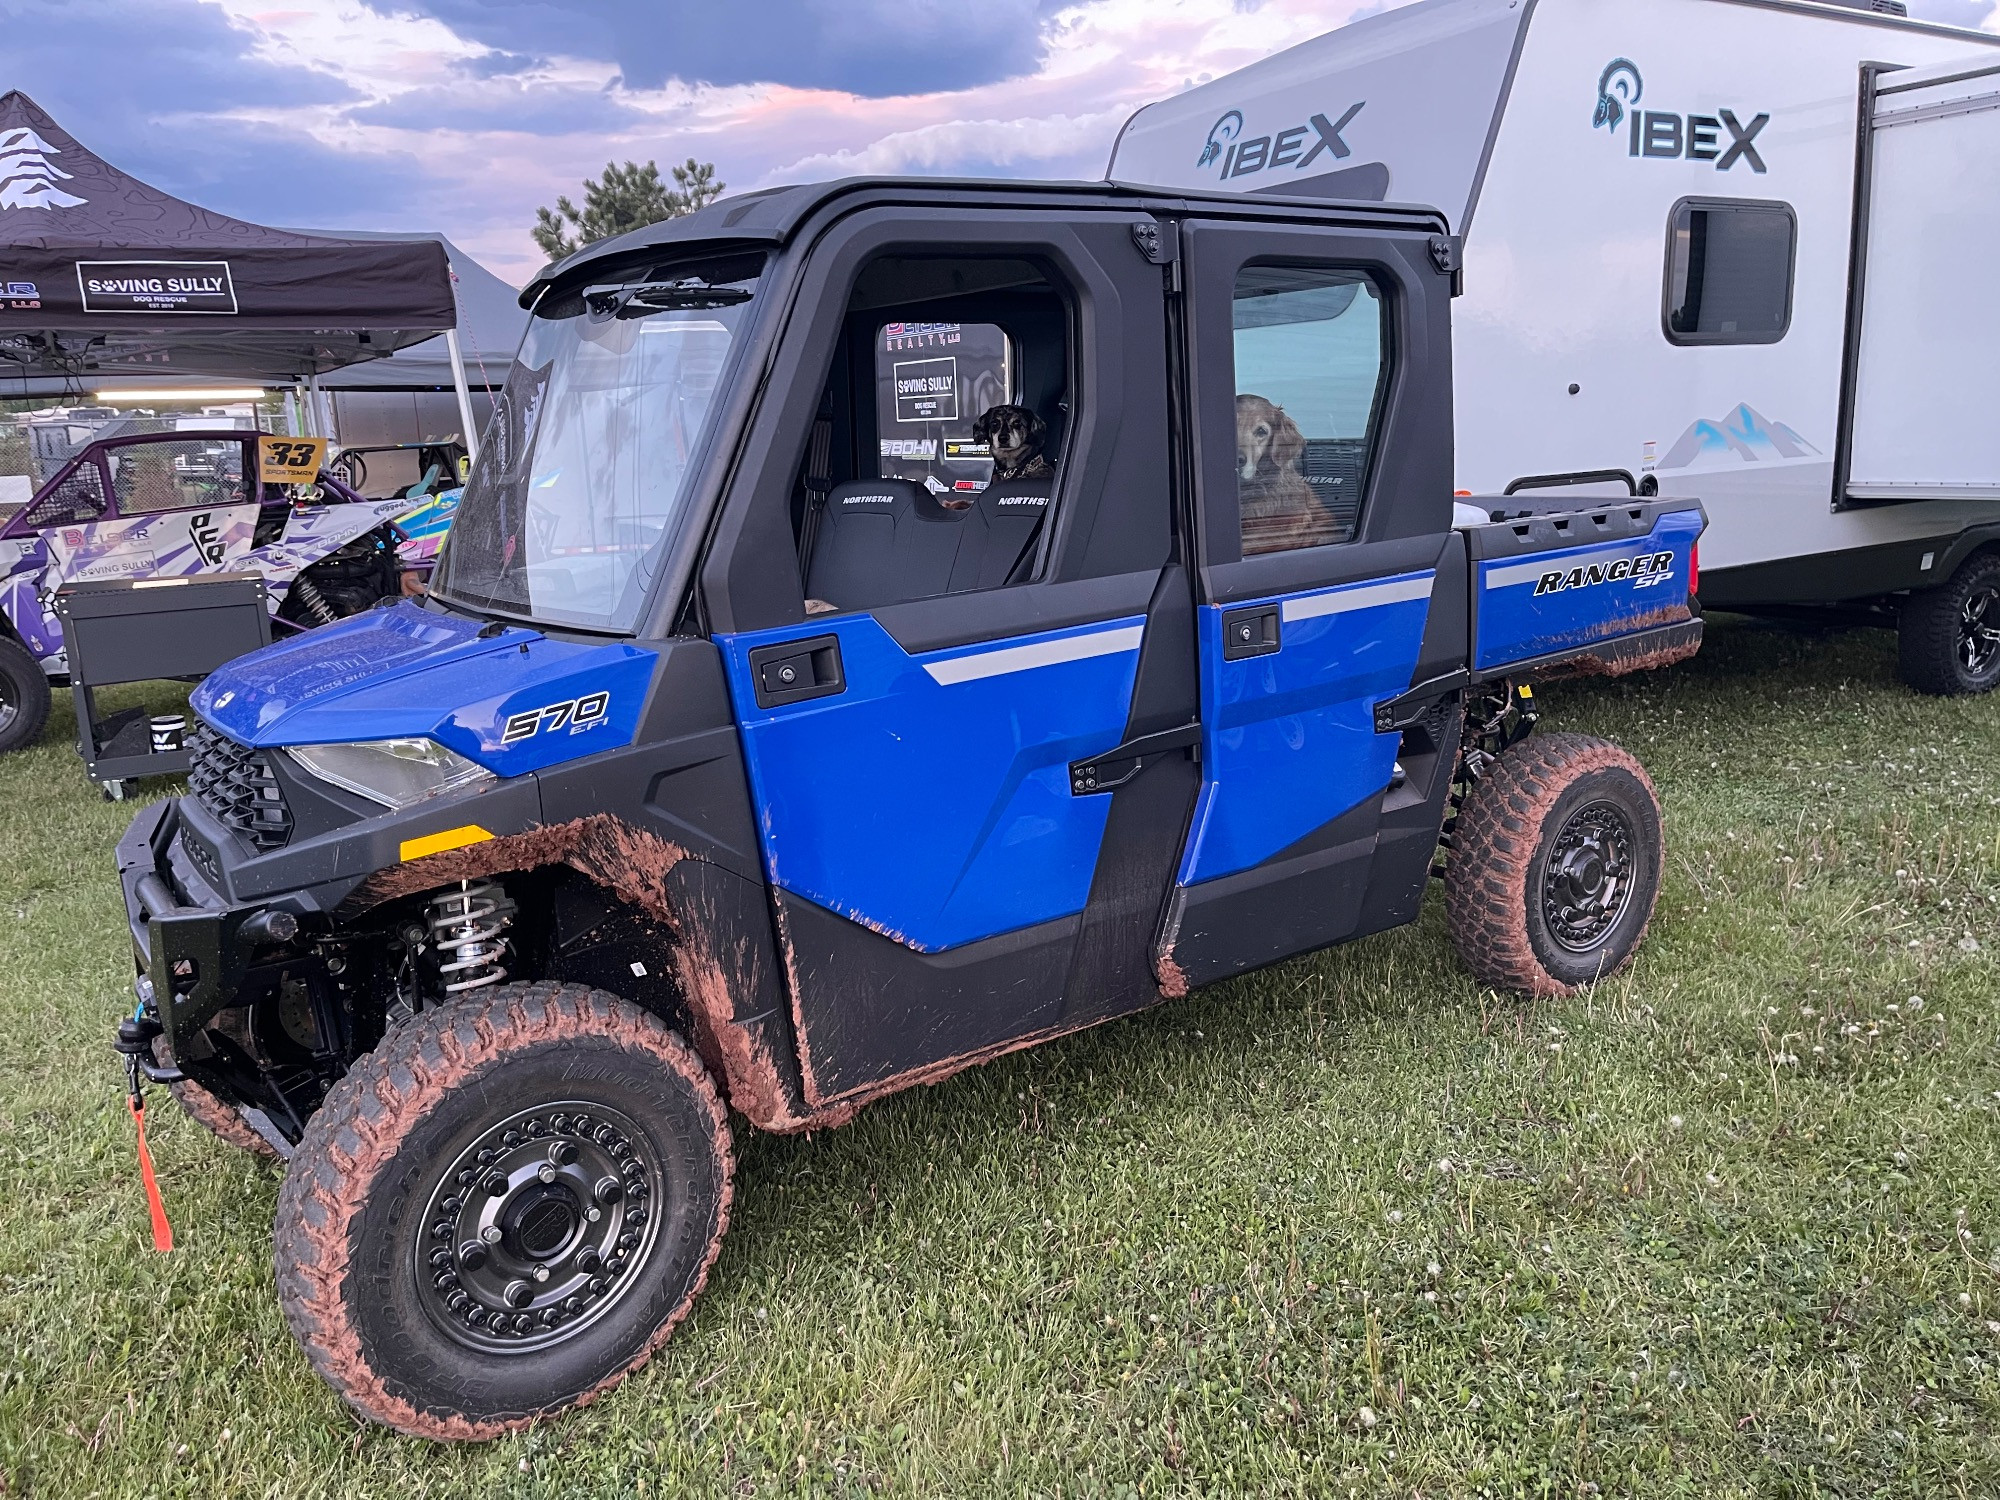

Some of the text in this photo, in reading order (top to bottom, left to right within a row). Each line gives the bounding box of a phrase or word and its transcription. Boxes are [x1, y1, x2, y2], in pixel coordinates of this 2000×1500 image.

[1219, 100, 1367, 181] IBEX
[1628, 108, 1771, 174] IBEX
[87, 277, 223, 292] SVING SULLY
[897, 375, 953, 394] SVING SULLY
[265, 442, 316, 467] 33
[890, 439, 938, 457] BOHN
[265, 469, 315, 477] SPORTSMAN
[842, 495, 894, 505] NORTHSTAR
[317, 524, 358, 548] BOHN
[80, 559, 152, 577] SVING SULLY
[1533, 551, 1675, 597] RANGER
[1633, 571, 1675, 590] SP
[500, 690, 610, 745] 570
[569, 716, 610, 736] EFI
